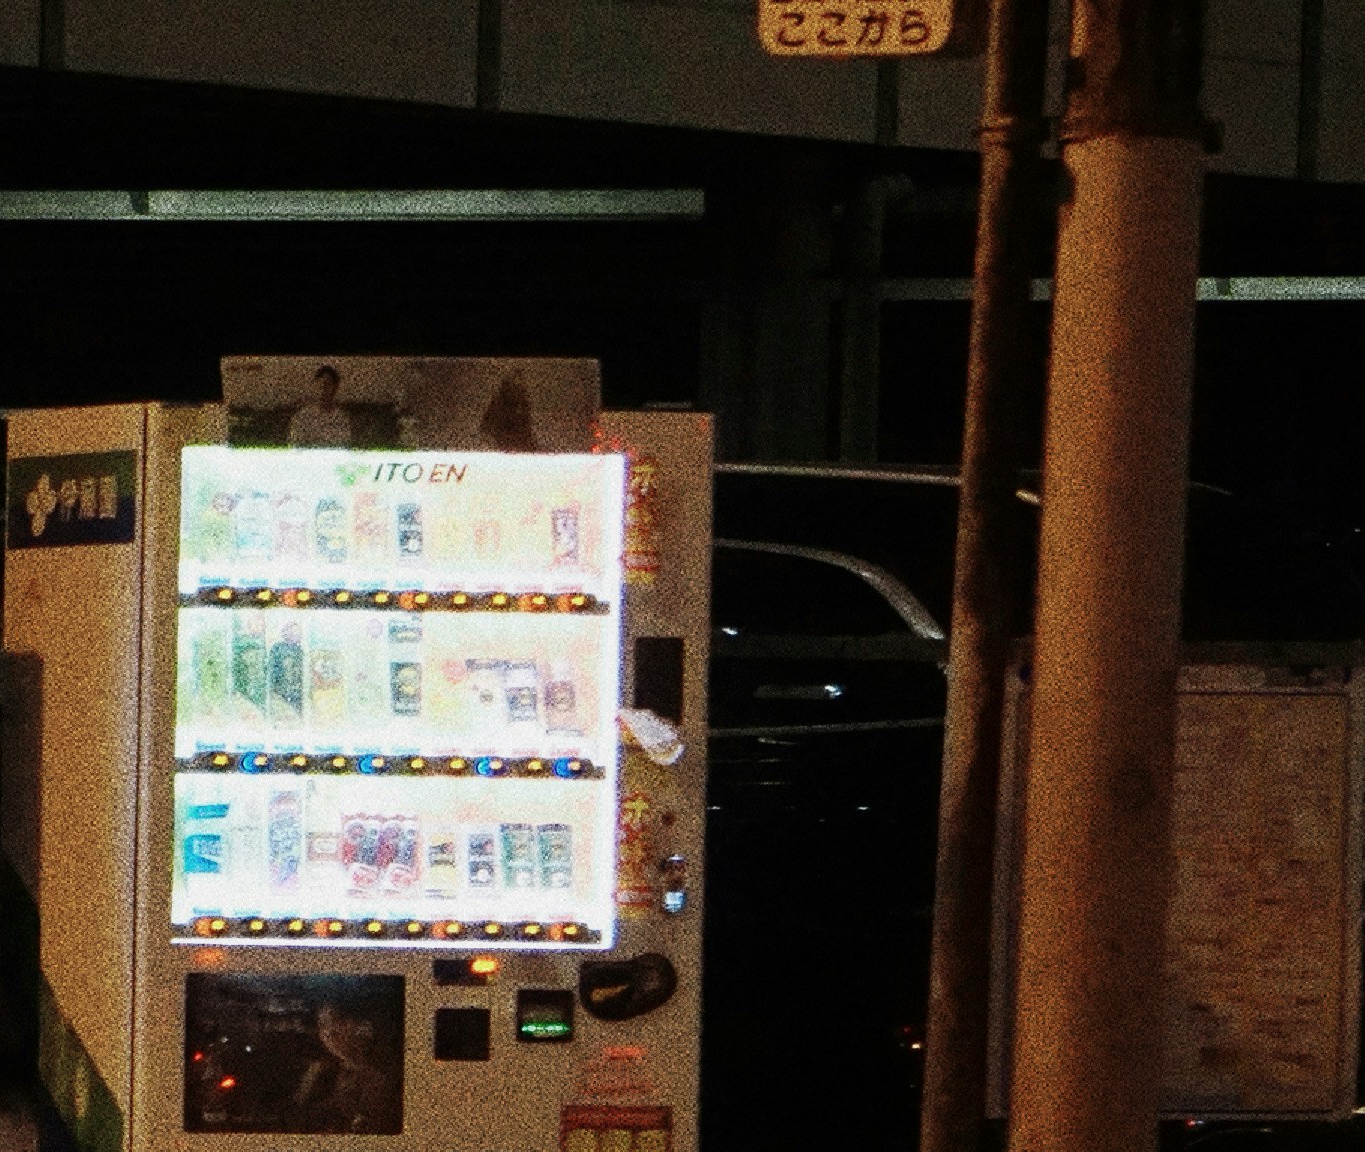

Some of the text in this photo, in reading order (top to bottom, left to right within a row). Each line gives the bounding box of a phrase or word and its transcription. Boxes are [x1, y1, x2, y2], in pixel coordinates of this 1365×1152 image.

[776, 9, 931, 47] ここから
[373, 462, 468, 484] ITO EN
